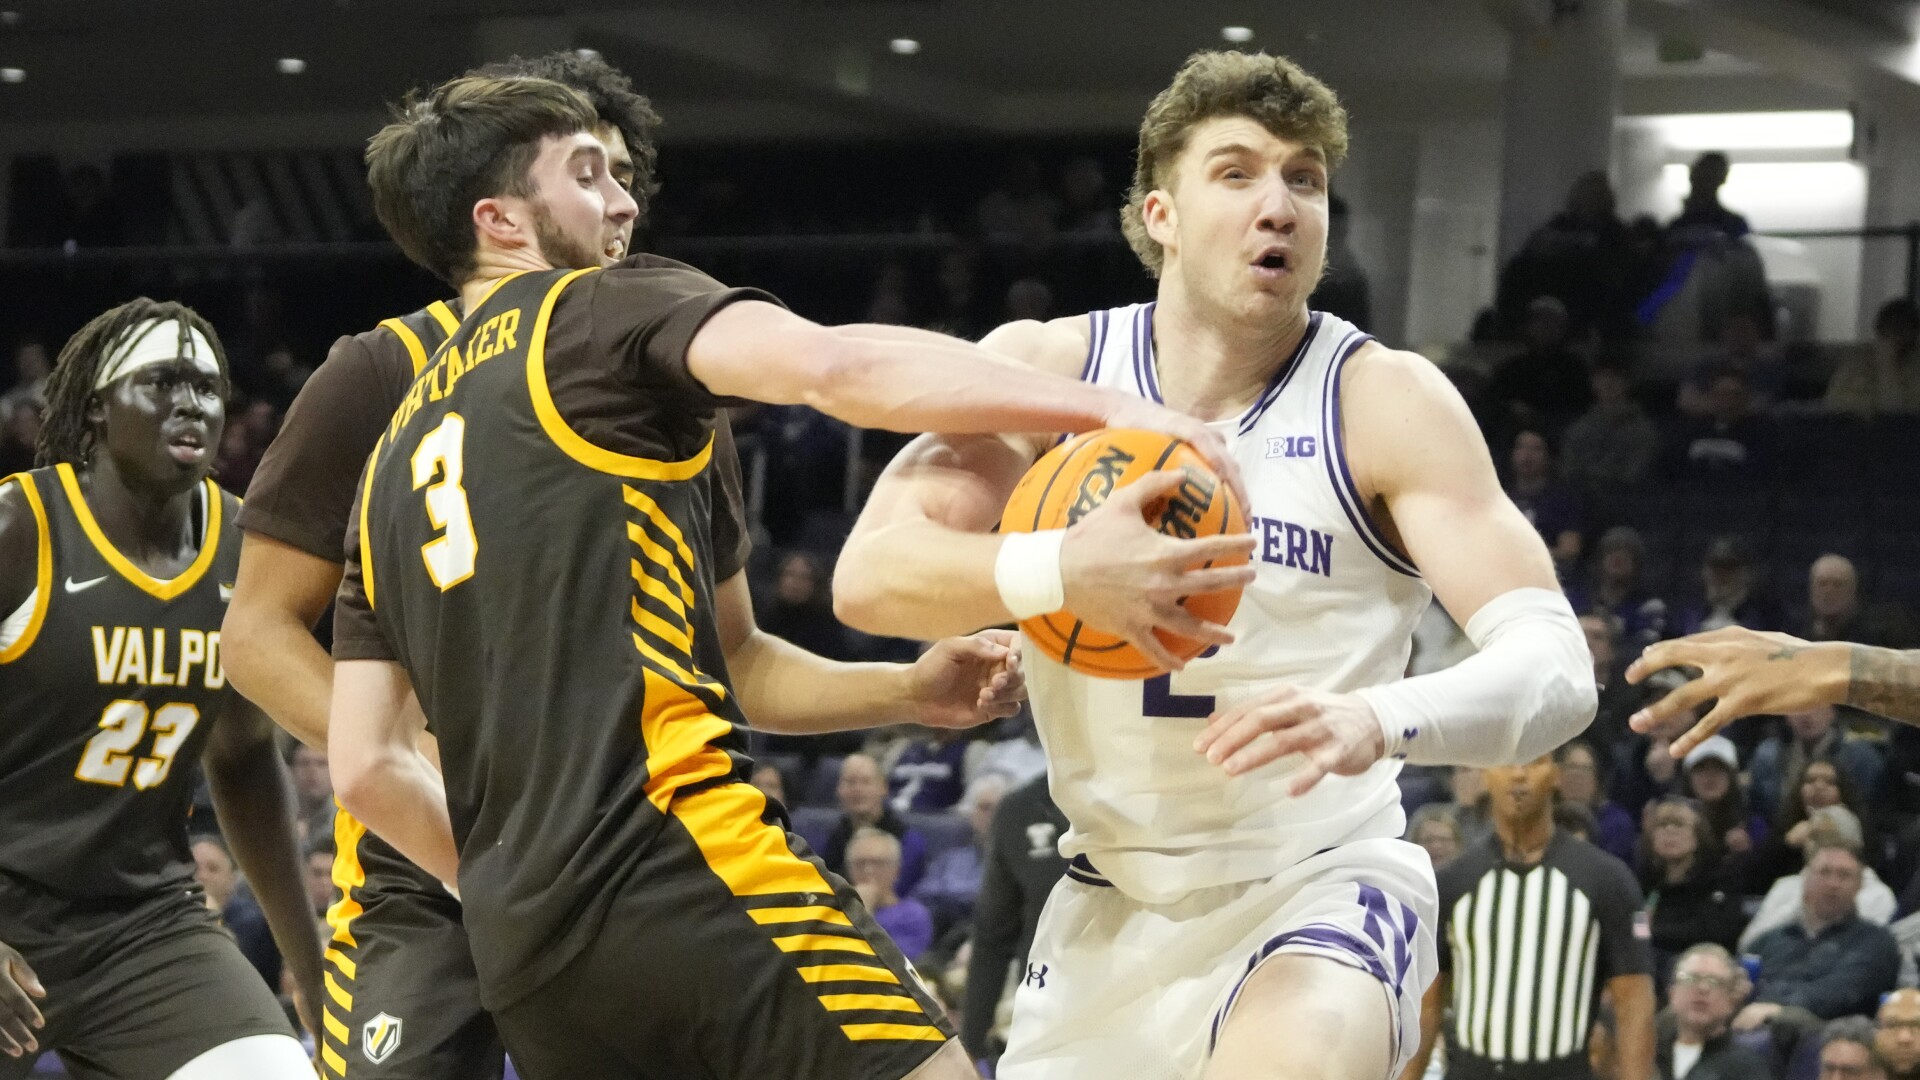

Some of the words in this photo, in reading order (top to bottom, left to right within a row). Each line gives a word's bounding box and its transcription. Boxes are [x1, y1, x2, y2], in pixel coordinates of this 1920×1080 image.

[411, 411, 478, 592] 3
[1066, 445, 1136, 529] NCA
[91, 625, 226, 690] VALPO
[74, 698, 201, 791] 23
